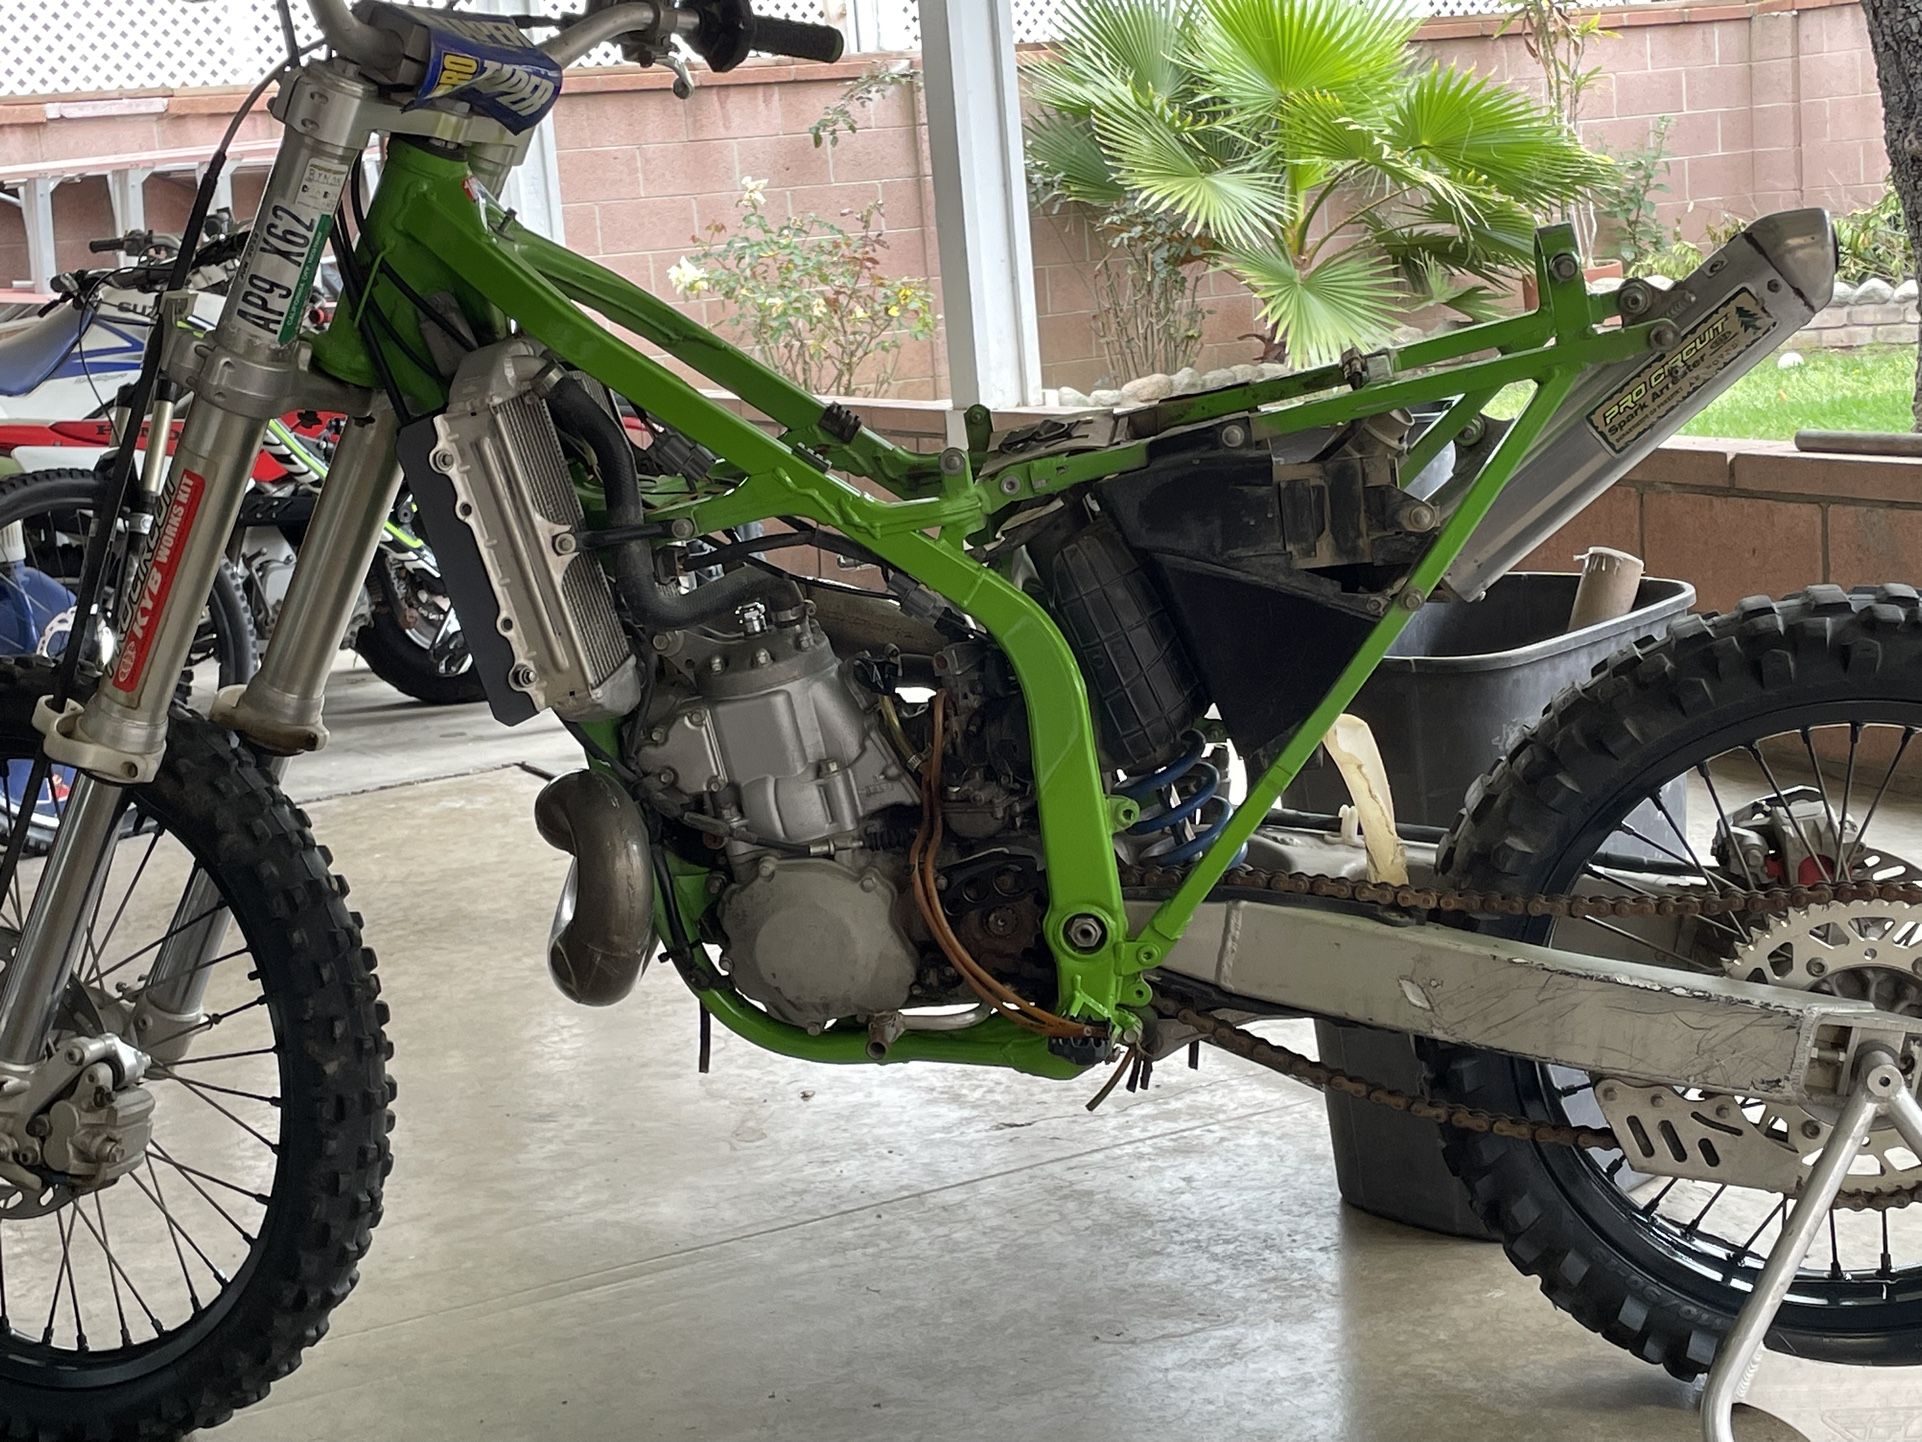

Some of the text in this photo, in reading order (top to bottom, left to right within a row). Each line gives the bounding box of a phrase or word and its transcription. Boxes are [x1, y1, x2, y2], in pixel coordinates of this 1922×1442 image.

[237, 205, 315, 335] AP9 X62
[1603, 313, 1730, 427] PRO CIRCUIT
[1607, 400, 1648, 437] Spark
[132, 474, 195, 640] KYB WORKS KIT
